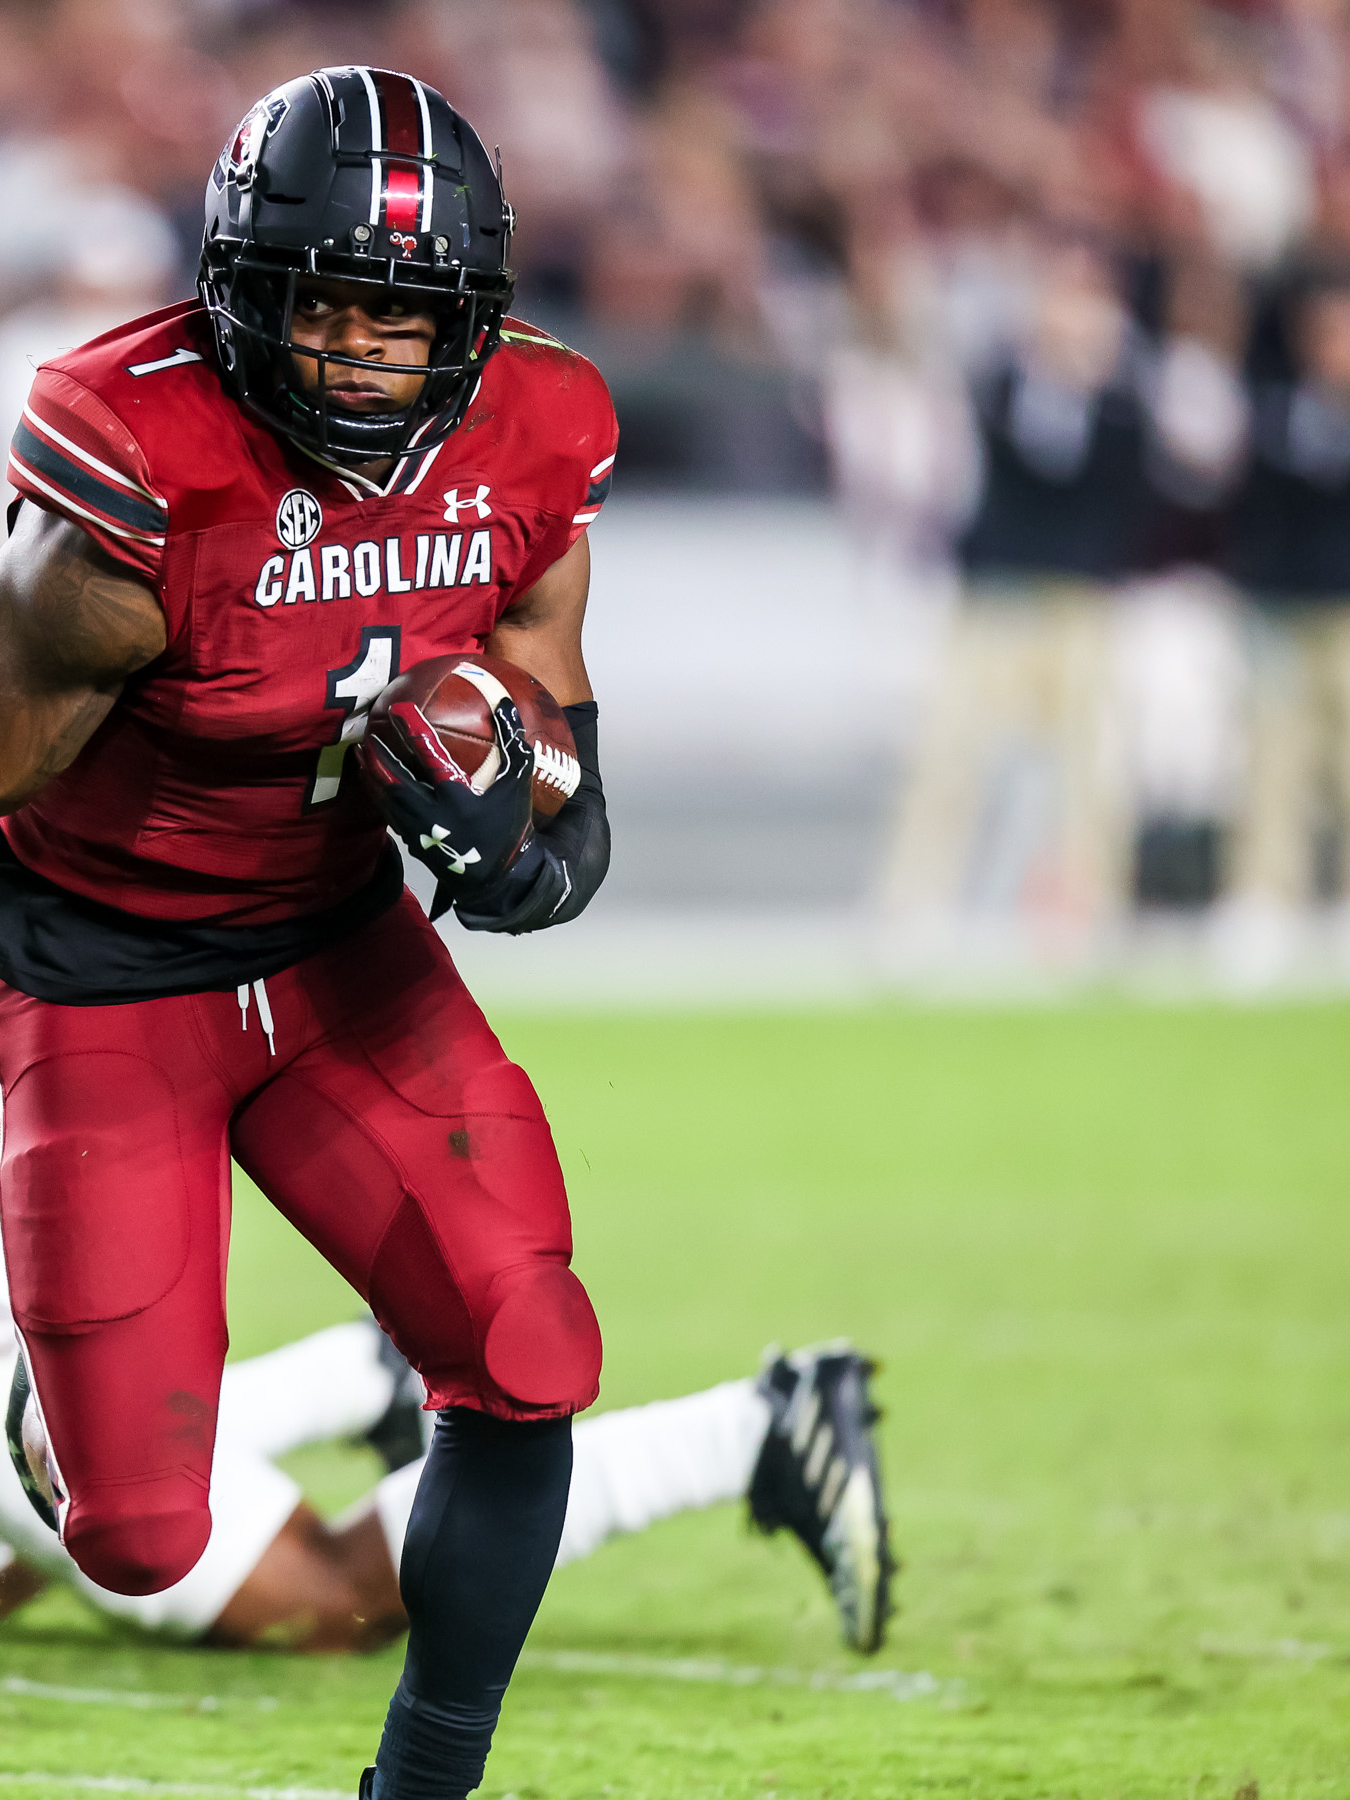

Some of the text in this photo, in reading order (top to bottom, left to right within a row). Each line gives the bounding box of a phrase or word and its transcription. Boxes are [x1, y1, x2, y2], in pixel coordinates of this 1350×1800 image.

[125, 347, 203, 377] 1
[278, 492, 322, 547] SEC
[253, 529, 492, 608] CAROLINA
[308, 632, 397, 808] 1
